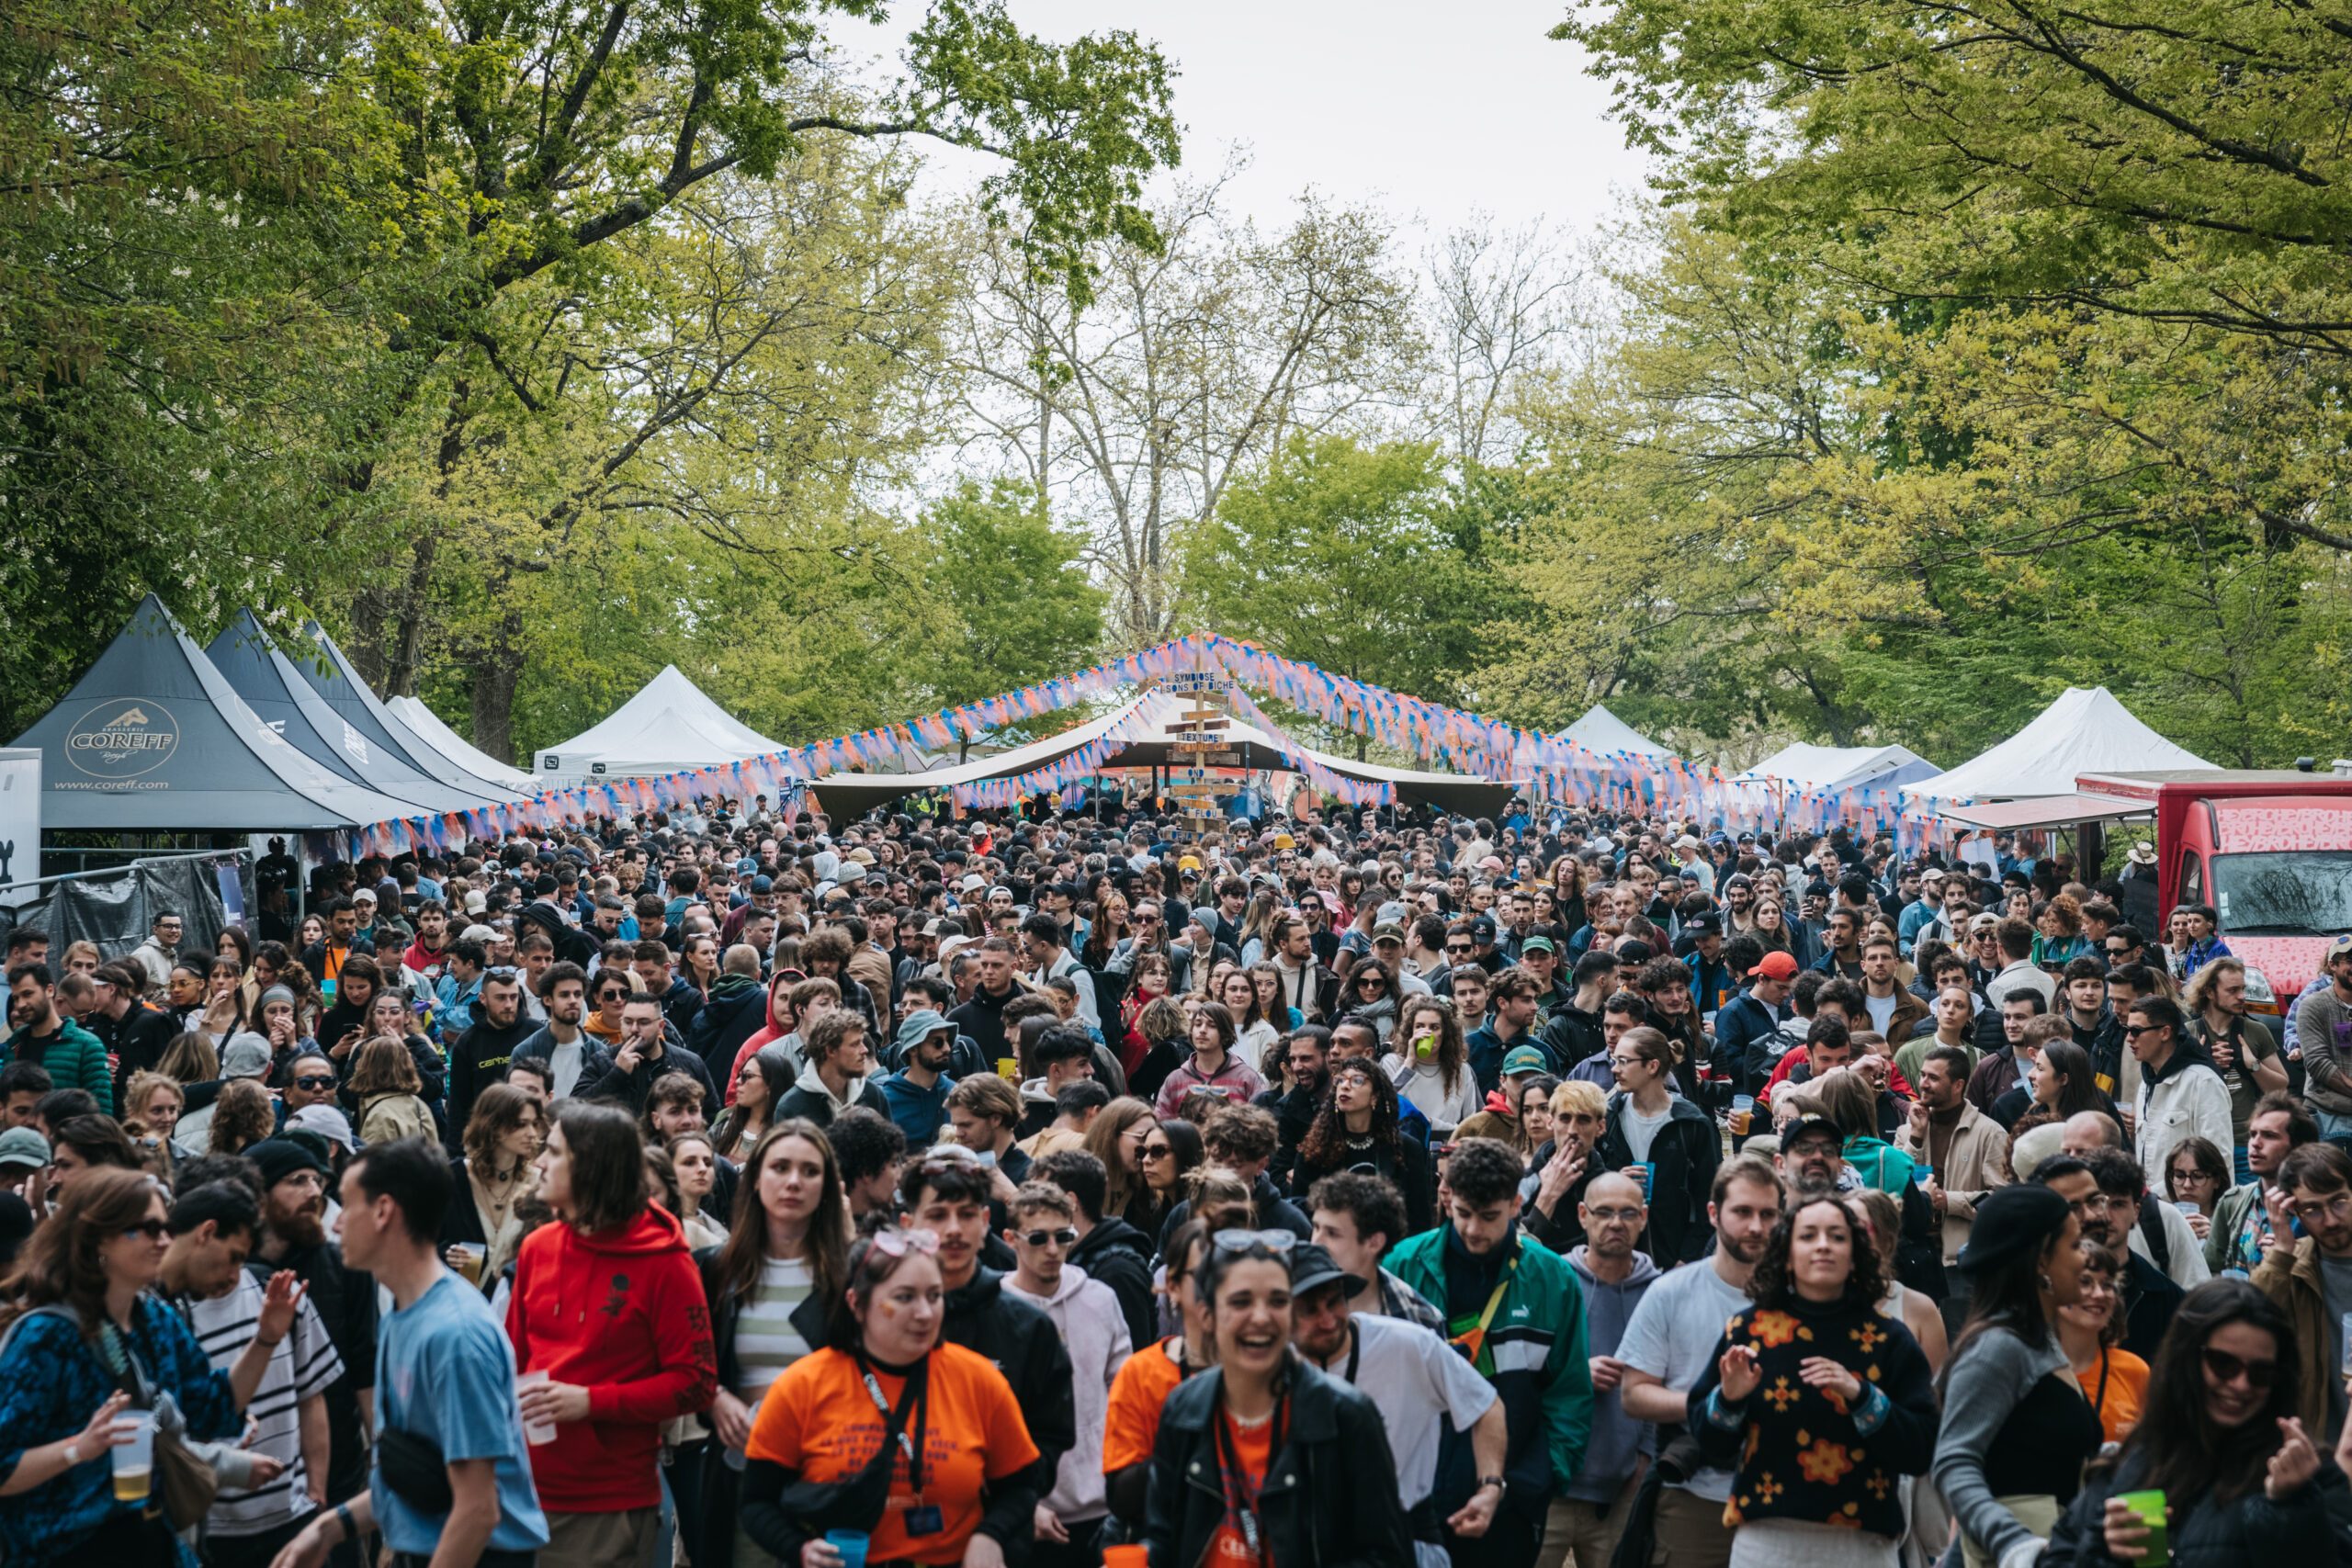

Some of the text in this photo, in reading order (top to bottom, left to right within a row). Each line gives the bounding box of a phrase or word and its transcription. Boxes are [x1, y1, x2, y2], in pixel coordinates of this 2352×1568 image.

[1174, 672, 1215, 682] SYMBIOSE
[1166, 681, 1234, 694] SONS OF BICHE
[71, 732, 173, 750] COREFF
[1182, 733, 1218, 742] TEXTURE
[54, 780, 169, 790] www.coreff.com
[1195, 809, 1217, 818] FLOU
